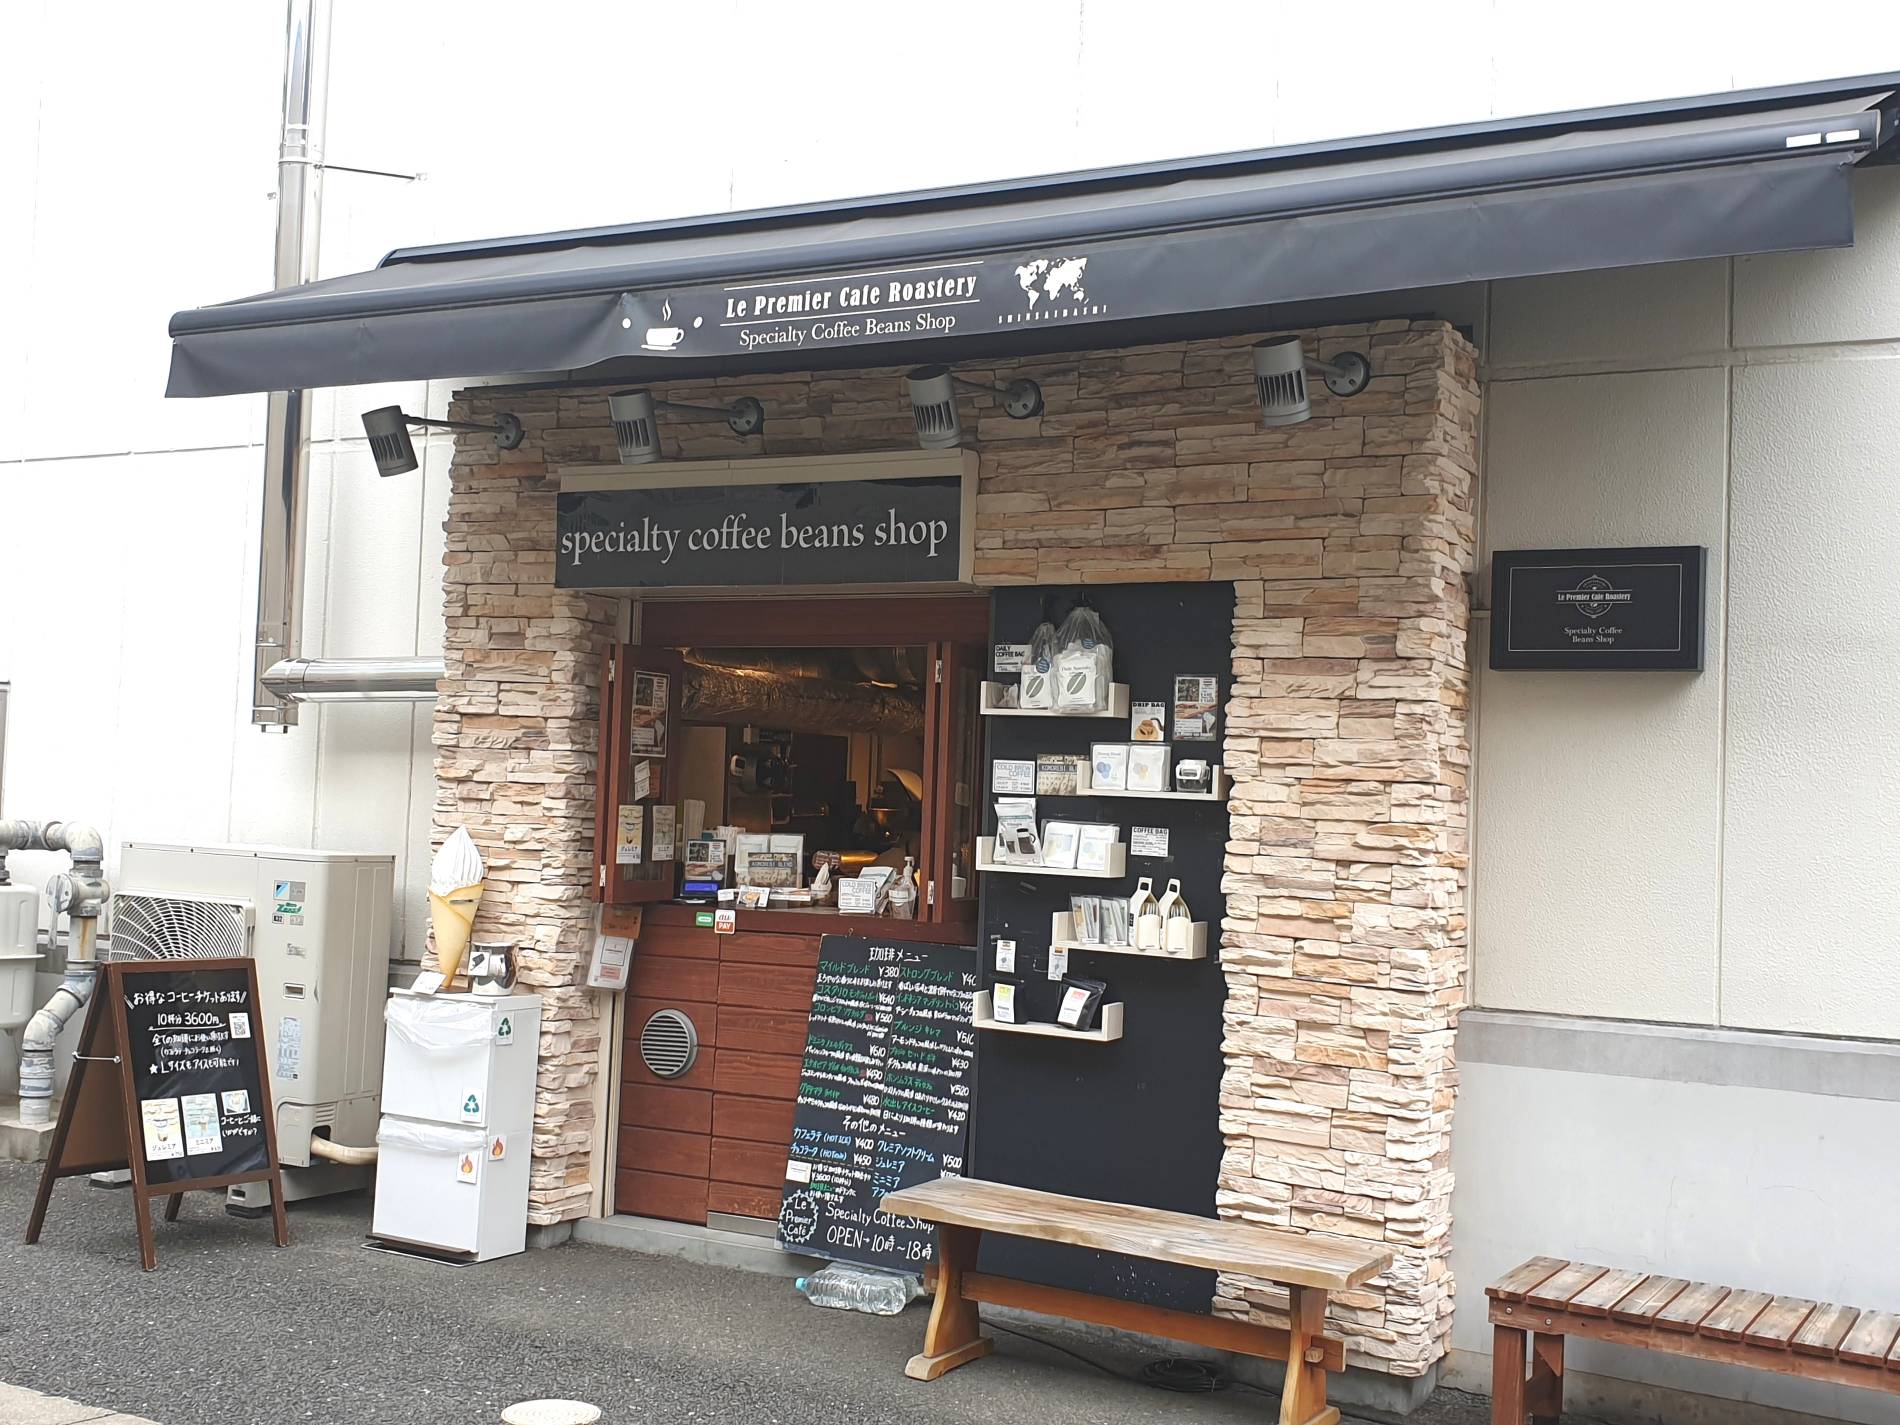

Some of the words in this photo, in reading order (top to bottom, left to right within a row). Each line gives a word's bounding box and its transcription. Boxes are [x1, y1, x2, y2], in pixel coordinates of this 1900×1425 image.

[726, 297, 747, 319] Le
[754, 290, 831, 317] Premier
[840, 286, 882, 309] Cafe
[888, 273, 978, 305] Roastery
[739, 320, 807, 349] Specialty
[811, 318, 861, 340] Coffee
[865, 316, 912, 337] Beans
[915, 311, 956, 335] Shop
[561, 515, 682, 566] specialty
[688, 512, 771, 551] coffee
[779, 512, 865, 549] beans
[874, 508, 949, 558] shop
[1564, 626, 1596, 637] Specialty
[1599, 626, 1623, 635] Coffee
[1572, 635, 1594, 643] Beans
[1595, 635, 1615, 645] Shop
[718, 922, 731, 930] PAY
[868, 946, 929, 962] 珈琲メニュー
[878, 966, 900, 978] ¥380
[184, 1012, 220, 1026] 3600円
[842, 1115, 906, 1138] その他のメニュー
[793, 1127, 823, 1142] カフェラテ
[854, 1136, 875, 1150] ¥400
[853, 1152, 872, 1166] ¥450
[877, 1140, 935, 1164] クレミアソフトクリーム
[942, 1153, 963, 1169] ¥500
[875, 1156, 906, 1173] ジュレミア
[872, 1172, 900, 1188] ミニミア
[794, 1198, 807, 1210] Le
[824, 1201, 872, 1227] Specialty
[826, 1225, 864, 1249] OPEN
